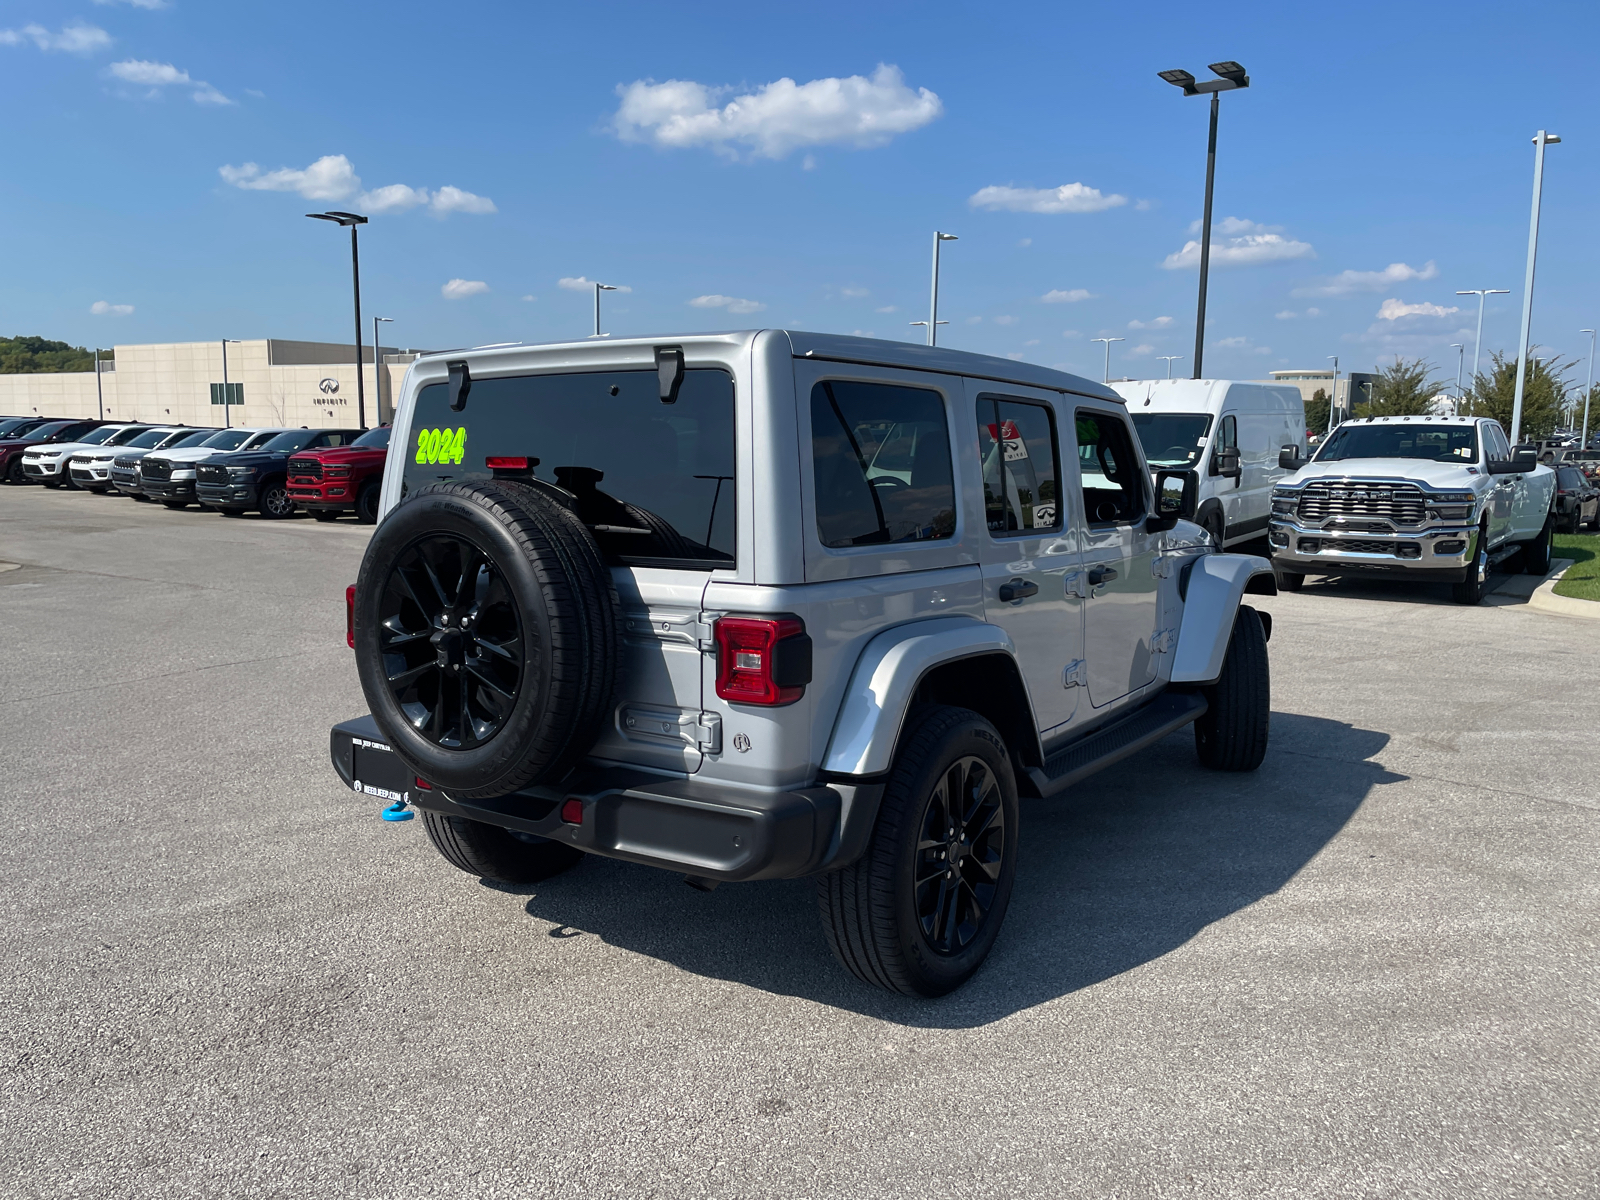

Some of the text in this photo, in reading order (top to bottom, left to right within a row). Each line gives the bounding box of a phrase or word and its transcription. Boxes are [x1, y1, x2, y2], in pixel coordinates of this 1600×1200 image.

[313, 398, 347, 406] INFINITI
[415, 426, 466, 465] 2024
[1330, 490, 1391, 500] RAM
[433, 501, 474, 518] All-Weather
